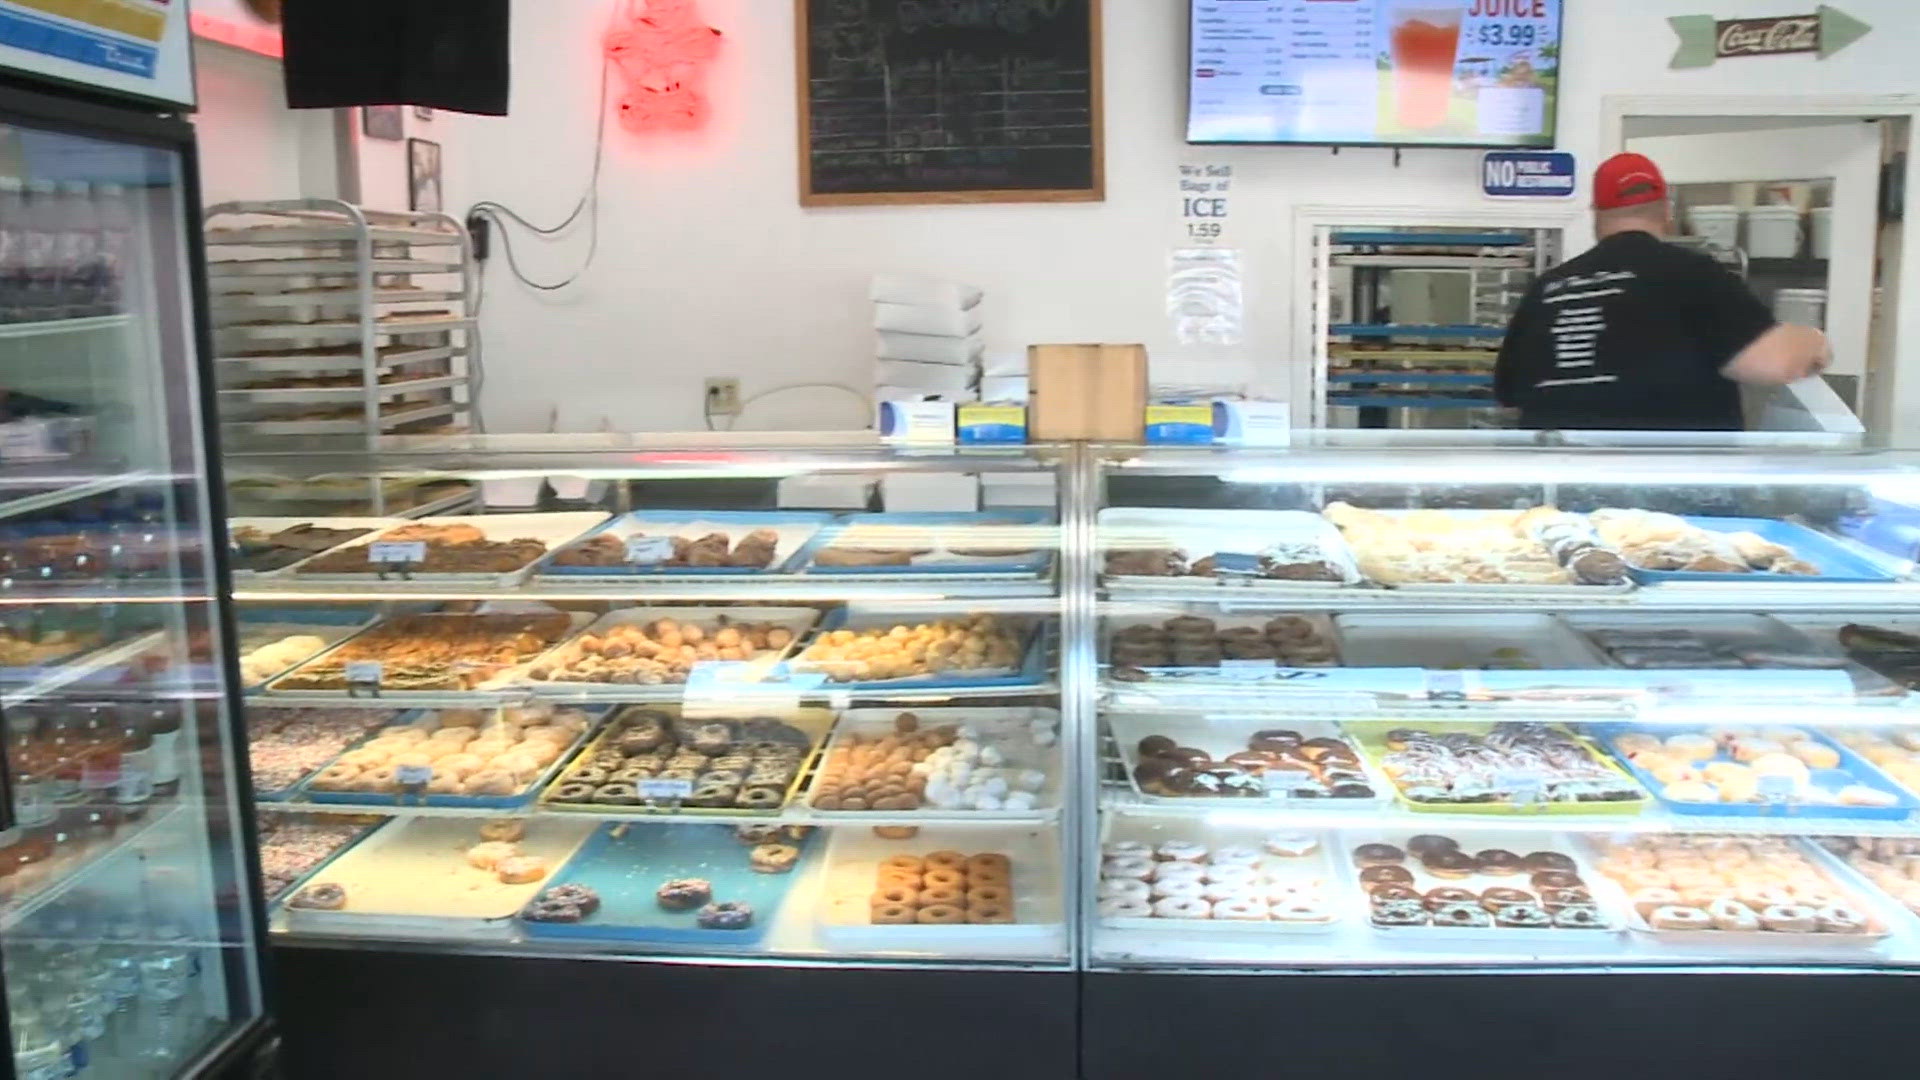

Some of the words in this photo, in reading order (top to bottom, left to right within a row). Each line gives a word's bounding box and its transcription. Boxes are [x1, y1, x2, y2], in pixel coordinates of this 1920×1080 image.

[1468, 0, 1546, 17] JUICE
[1479, 23, 1535, 46] $3.99
[1486, 161, 1515, 188] NO
[1183, 198, 1228, 217] ICE
[1187, 223, 1222, 237] 1.59
